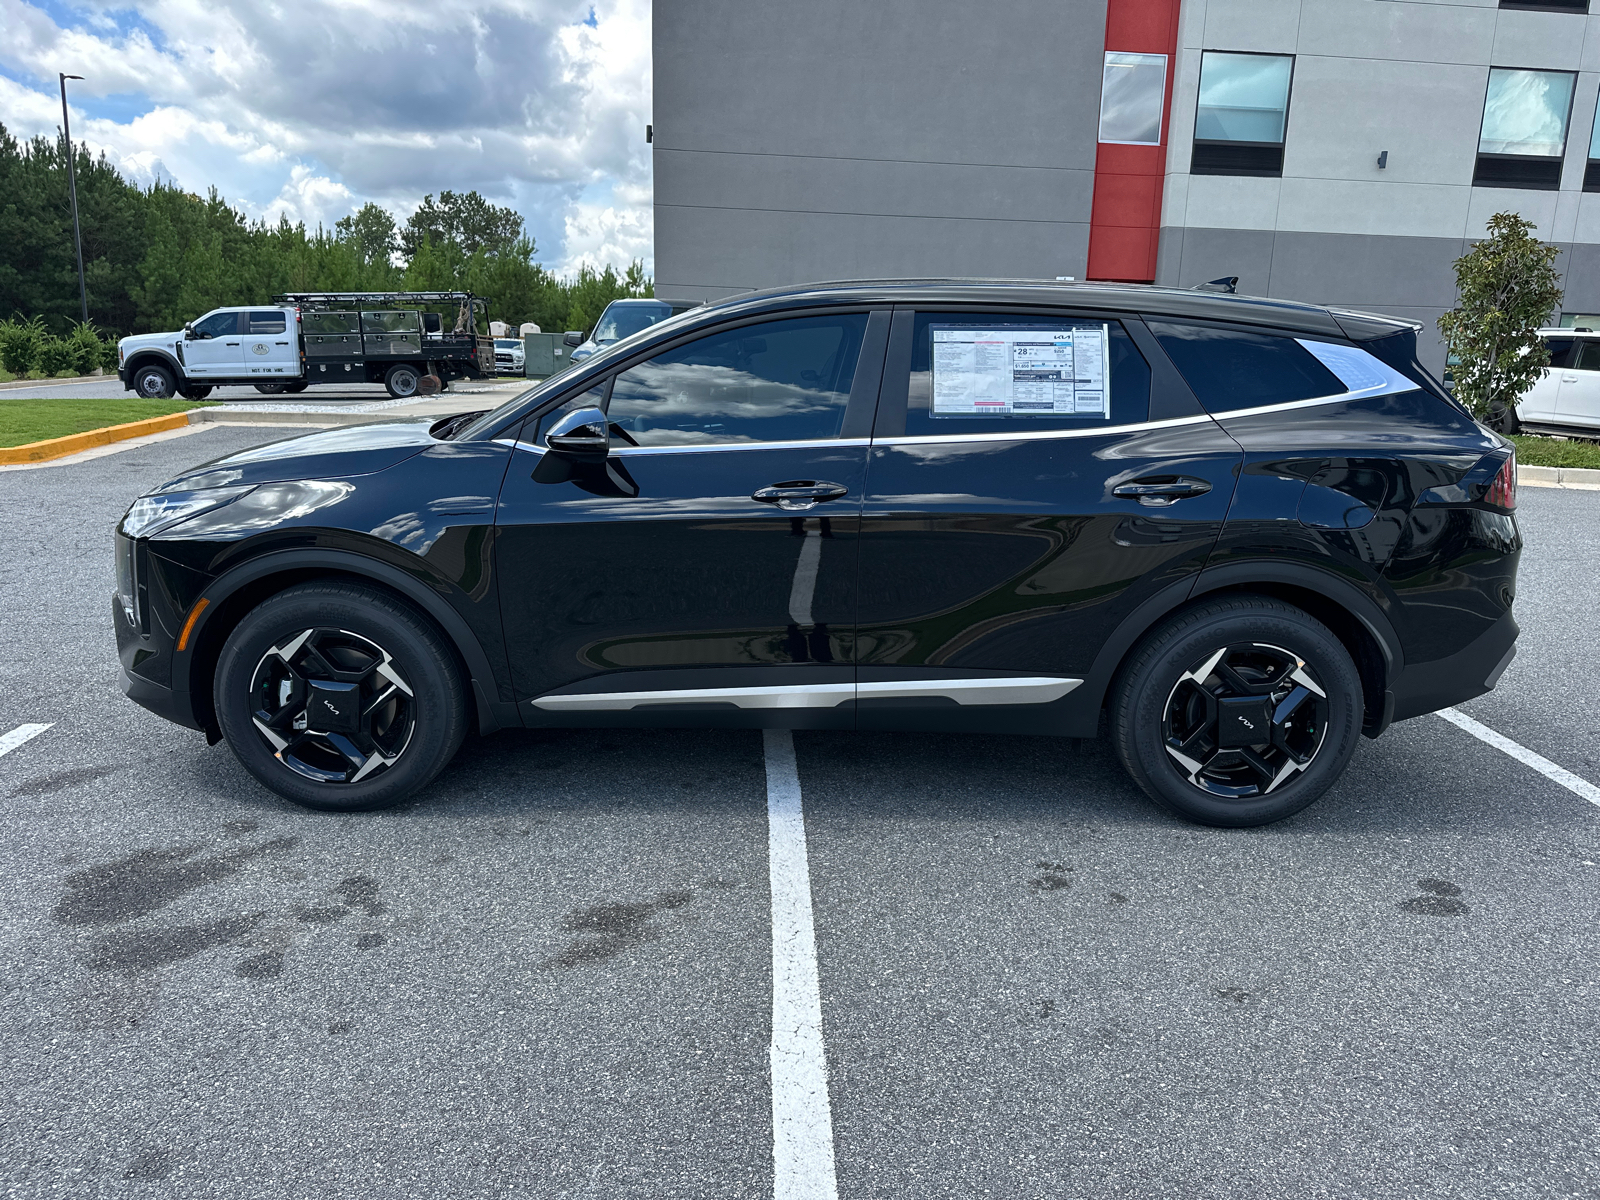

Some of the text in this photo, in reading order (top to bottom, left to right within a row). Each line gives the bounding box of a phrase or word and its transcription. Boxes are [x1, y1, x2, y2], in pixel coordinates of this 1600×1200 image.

[1167, 627, 1227, 668] KUMHO
[323, 699, 340, 716] KIA
[1237, 715, 1254, 730] KIA
[1337, 692, 1354, 757] CRUGEN
[337, 781, 400, 807] KUMHO
